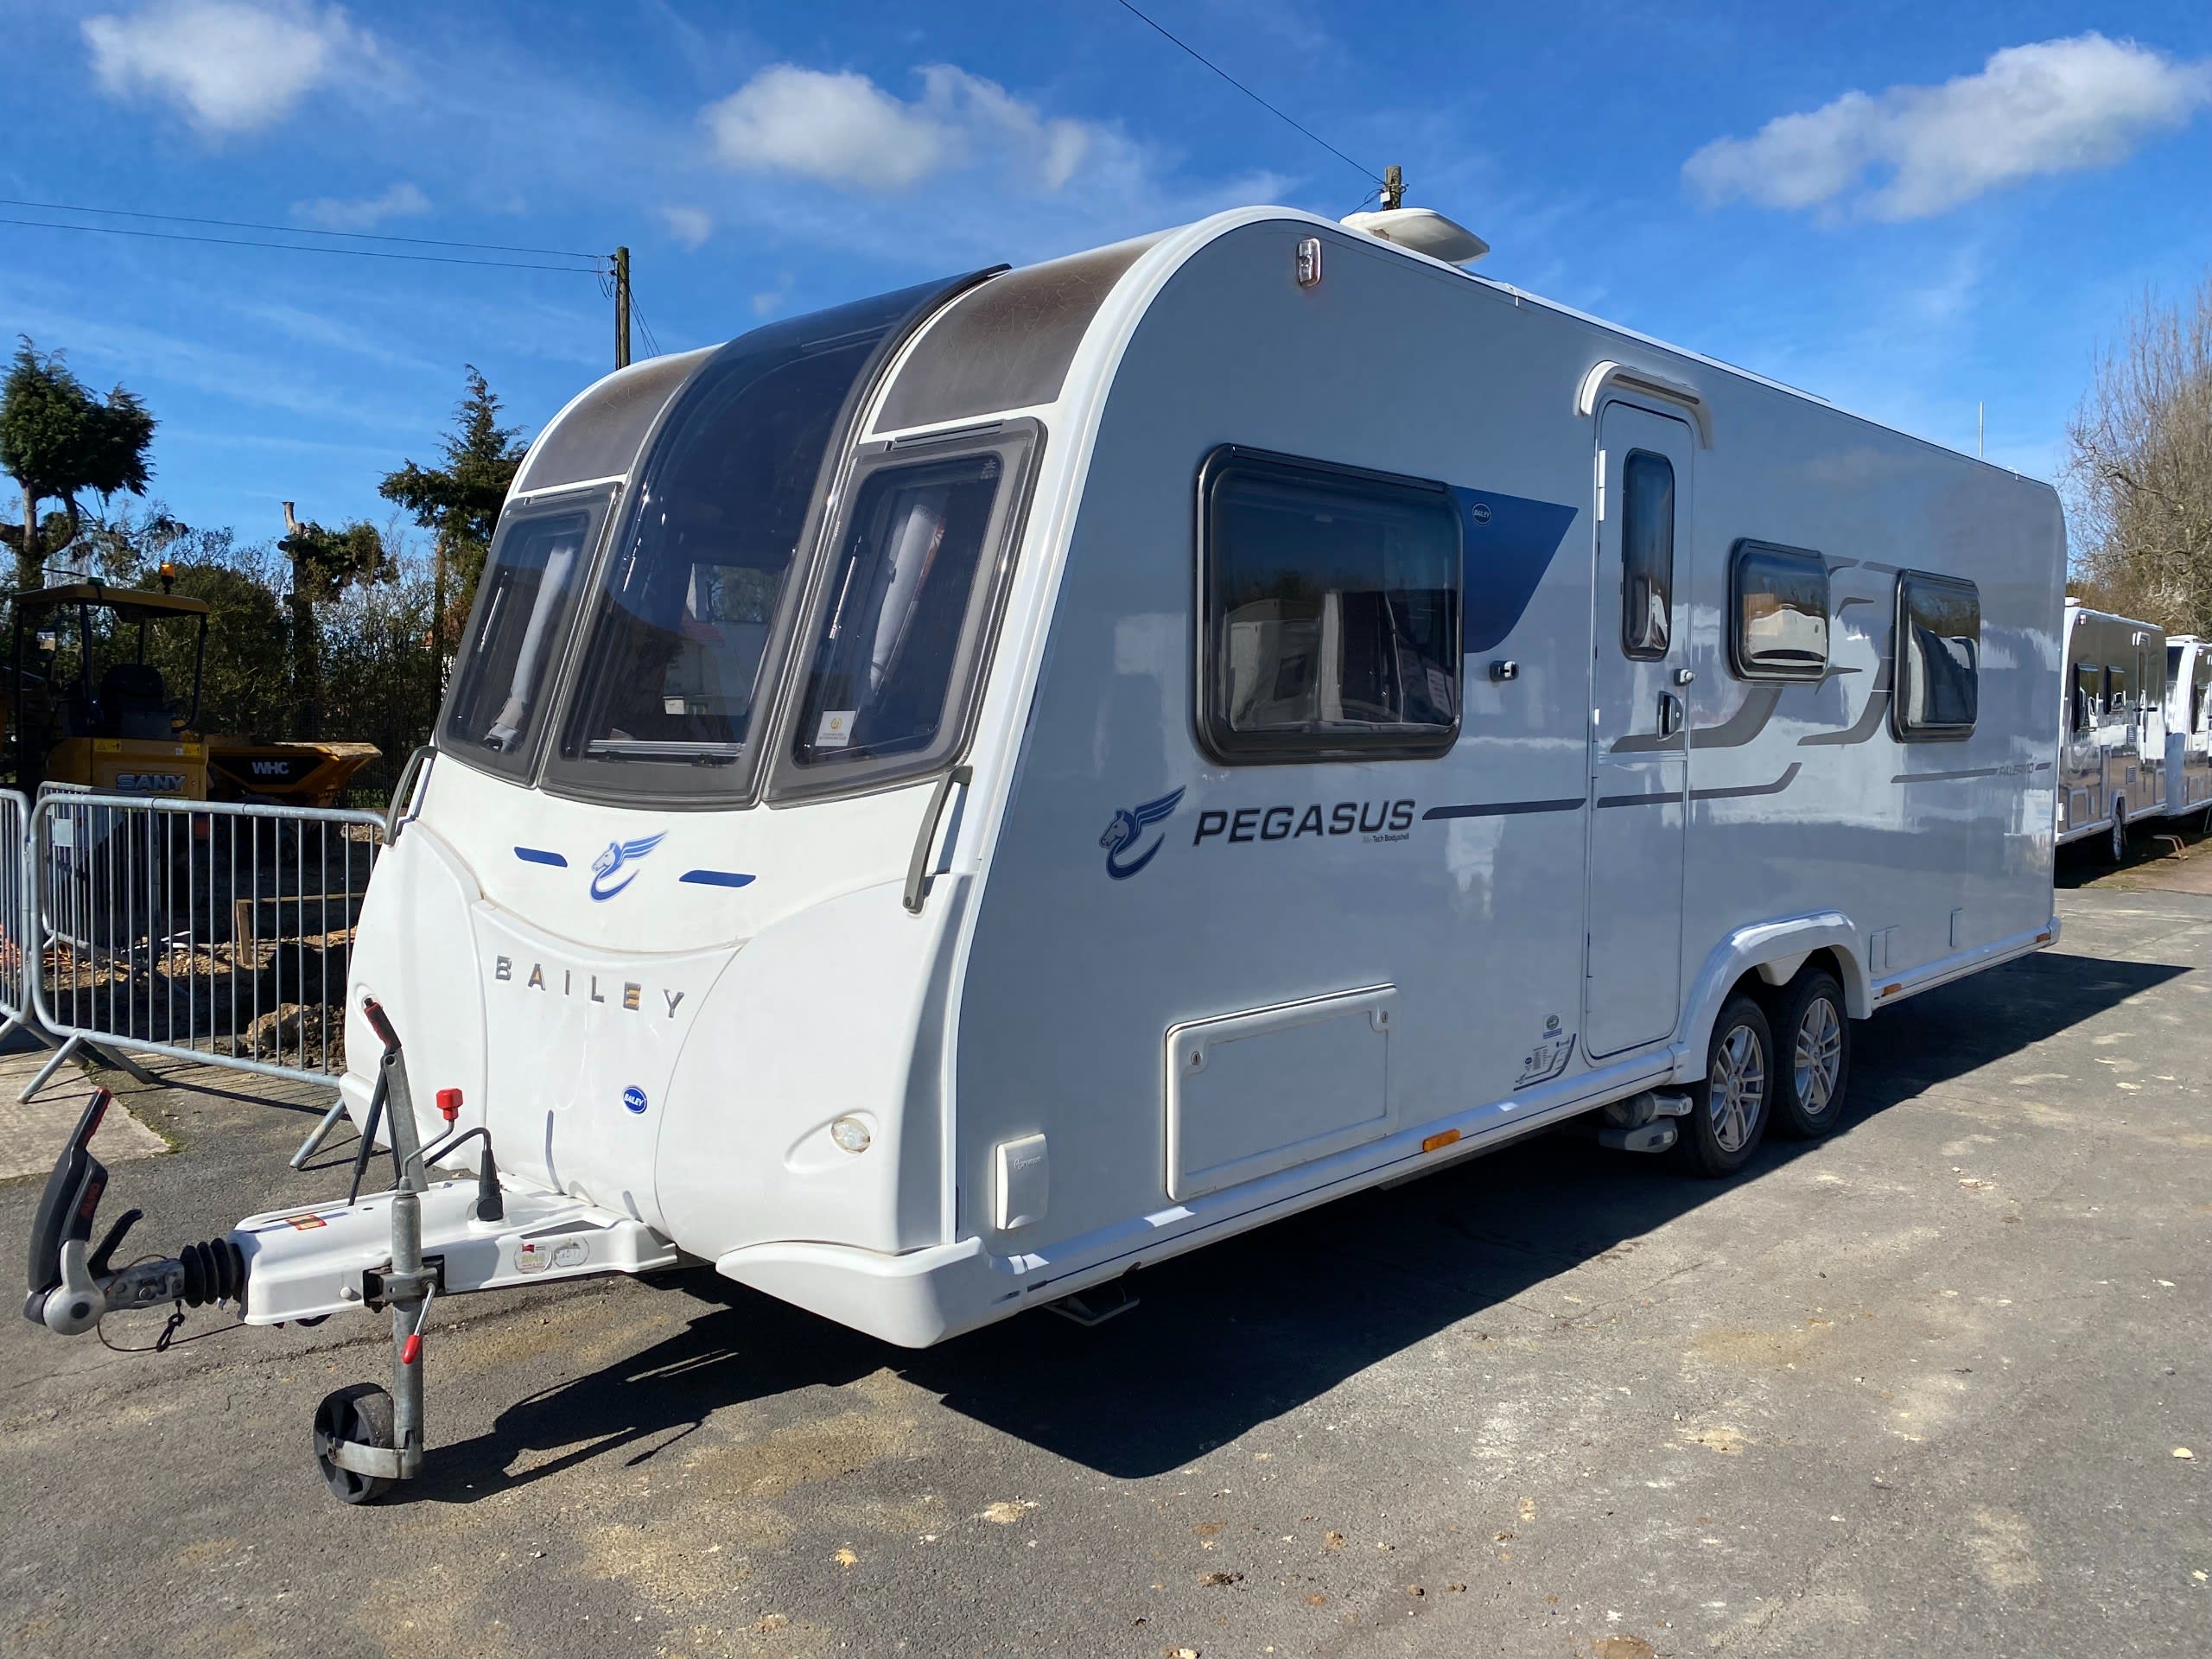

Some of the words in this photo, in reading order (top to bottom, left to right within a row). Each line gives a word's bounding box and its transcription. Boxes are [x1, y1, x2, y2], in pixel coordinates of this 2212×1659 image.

[1474, 509, 1490, 518] BAILEY
[251, 761, 289, 775] WHC
[116, 773, 187, 791] SANY
[1192, 798, 1416, 847] PEGASUS
[495, 955, 684, 1018] BAILEY
[624, 1093, 644, 1106] BAILEY
